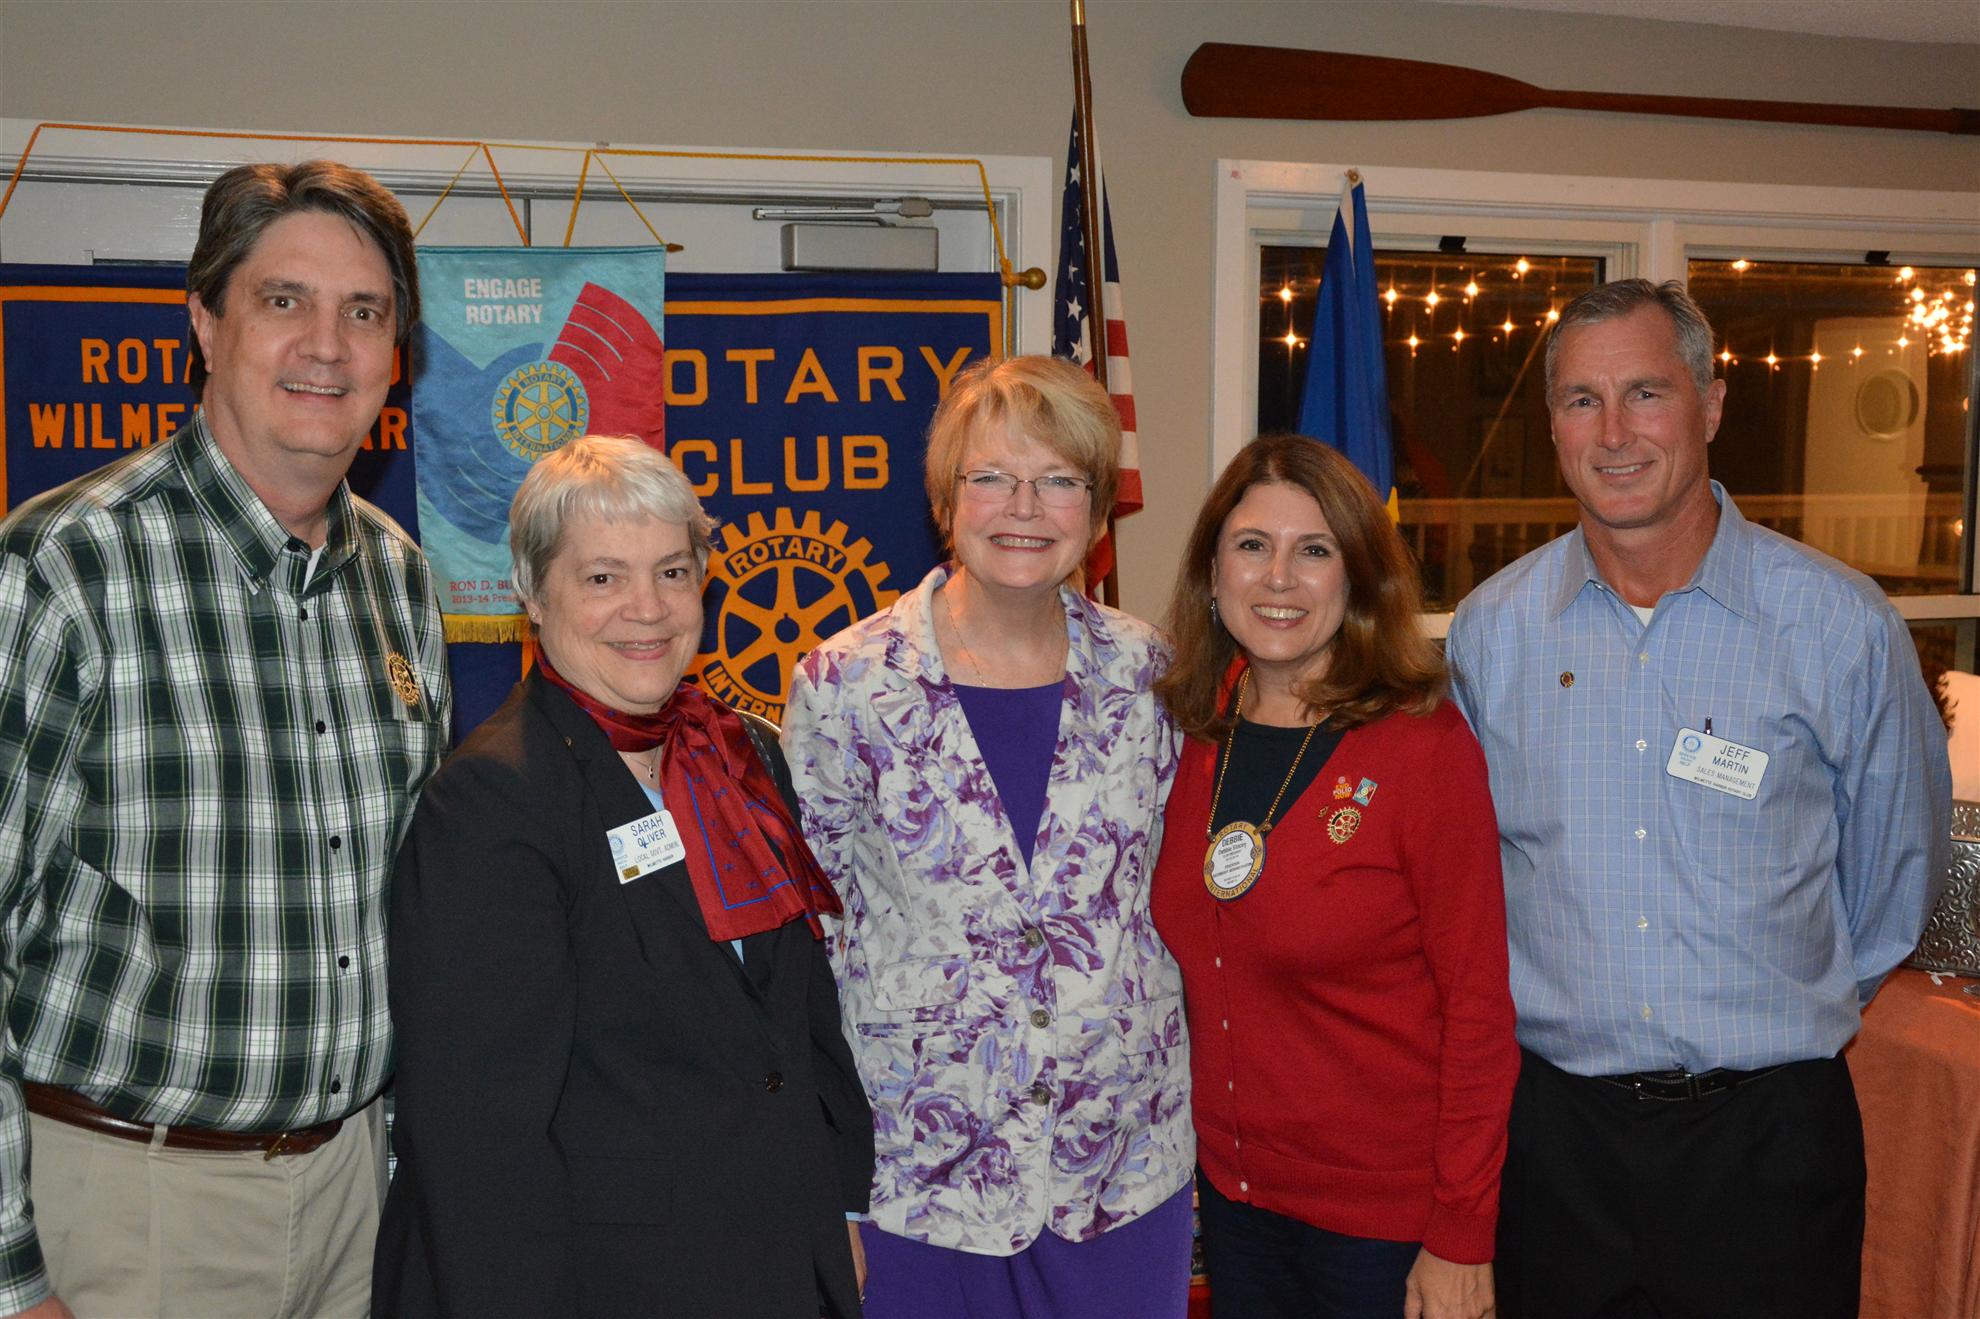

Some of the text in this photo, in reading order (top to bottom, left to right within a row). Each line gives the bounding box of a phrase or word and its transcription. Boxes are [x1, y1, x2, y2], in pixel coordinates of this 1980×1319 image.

[464, 278, 542, 298] ENGAGE
[466, 304, 542, 325] ROTARY
[81, 338, 194, 384] ROT
[664, 346, 972, 406] OTARY
[29, 403, 200, 449] WILME
[670, 435, 890, 498] CLUB
[728, 536, 844, 577] ROTARY
[449, 579, 514, 592] RON D. BU
[706, 665, 785, 728] INTERN
[1720, 745, 1750, 760] JEFF
[1696, 766, 1715, 777] SALES
[1712, 756, 1749, 775] MARTIN
[1716, 771, 1756, 789] MANAGEMENT
[631, 816, 663, 836] SARAH
[637, 829, 667, 847] OLIVER
[1222, 833, 1244, 847] DEBBIE
